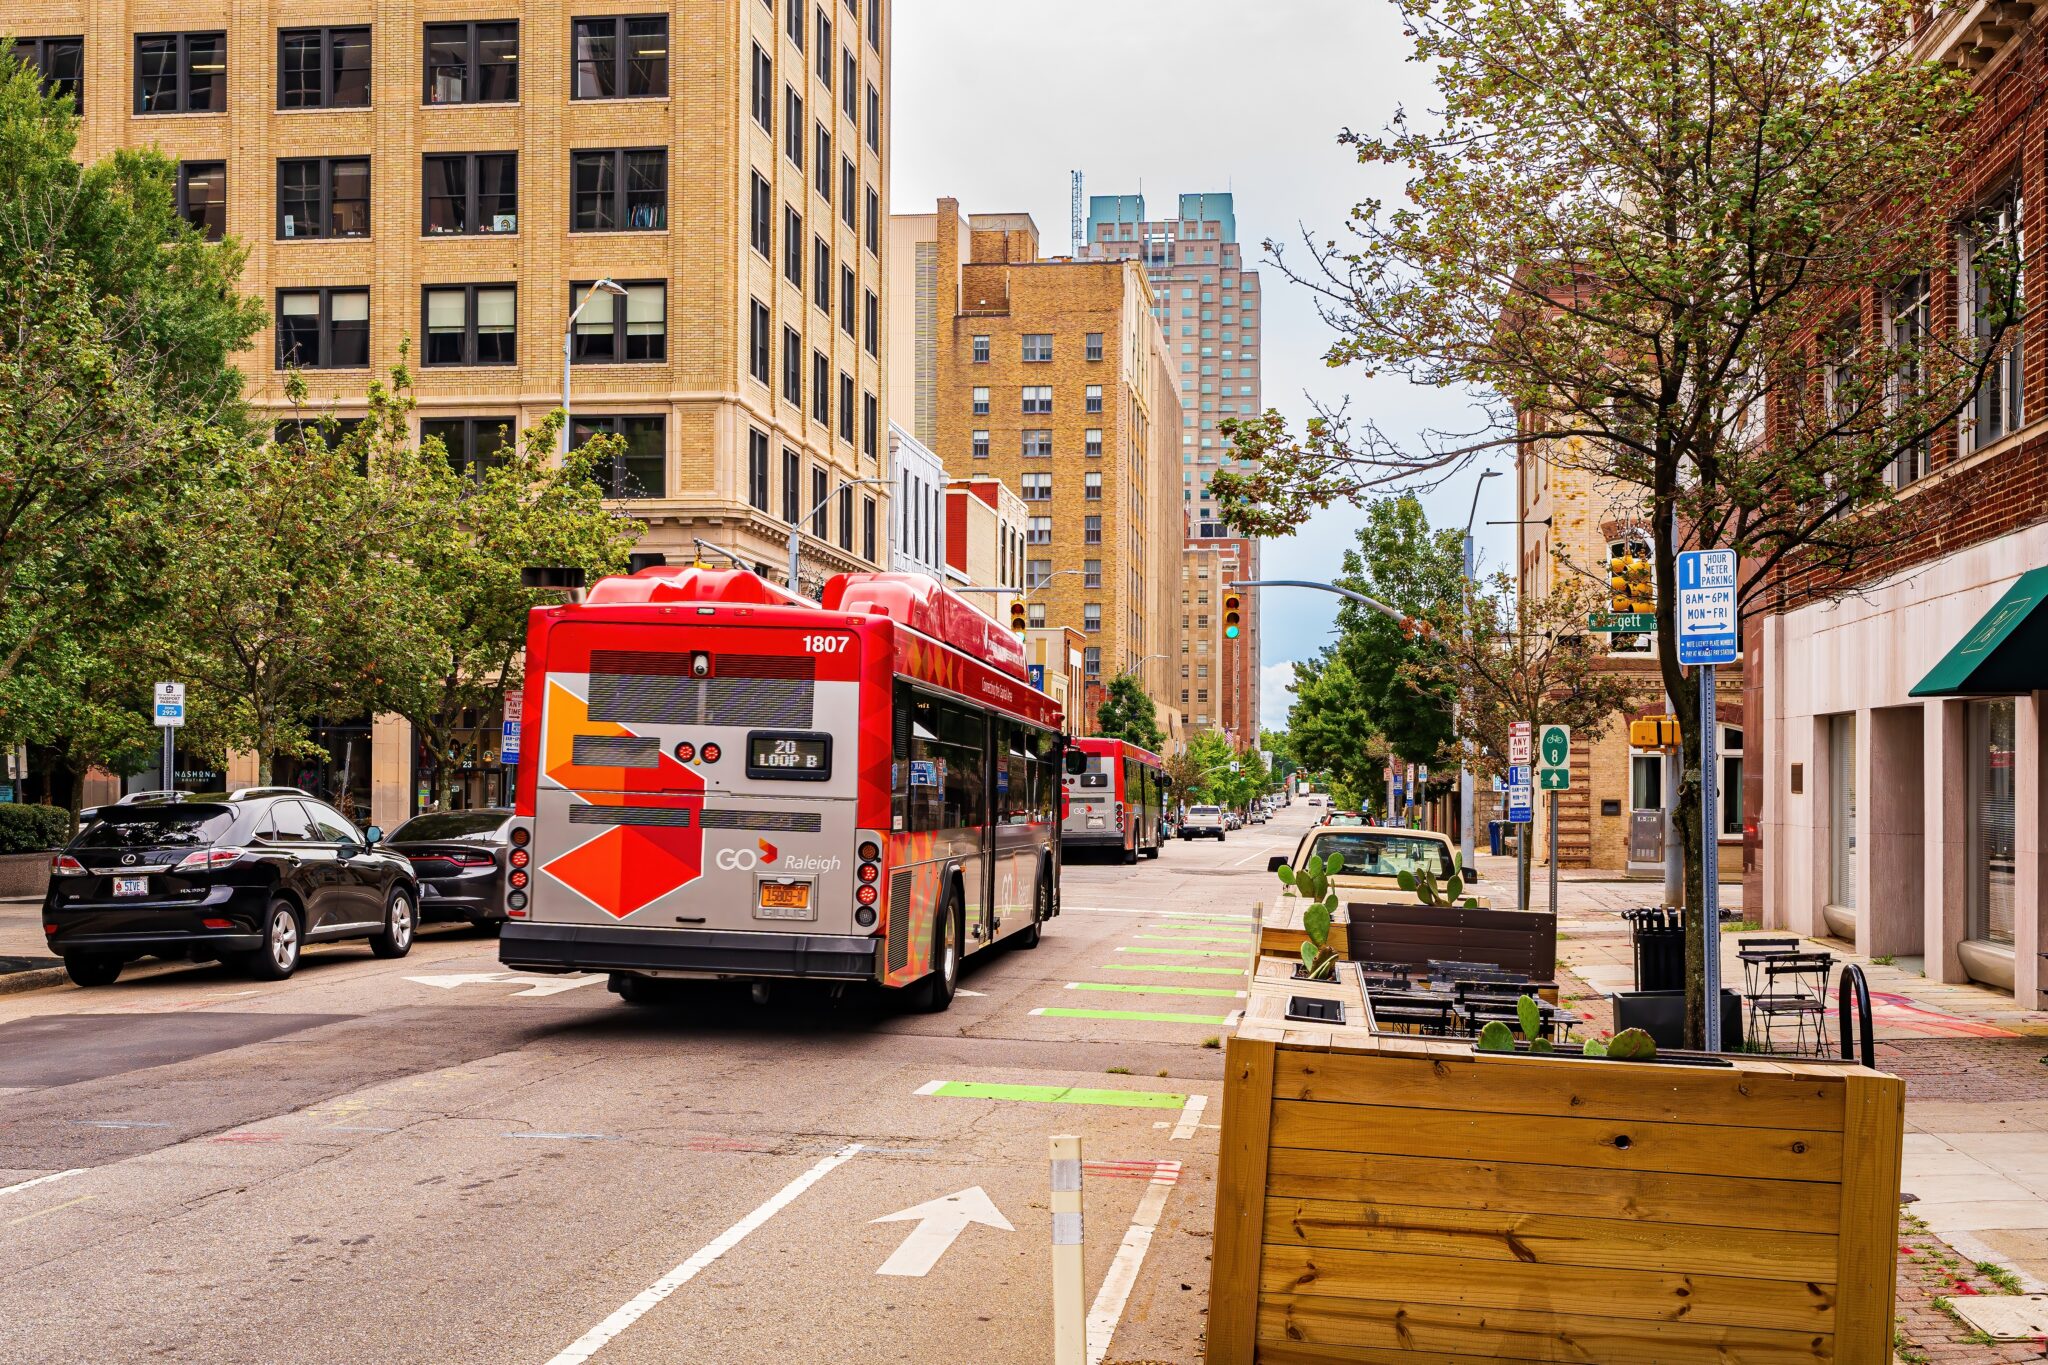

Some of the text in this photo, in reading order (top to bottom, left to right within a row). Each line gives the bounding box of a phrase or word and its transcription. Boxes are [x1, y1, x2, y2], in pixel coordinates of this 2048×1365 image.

[1687, 554, 1727, 584] 1 HOUR
[1706, 565, 1728, 575] METER
[1701, 575, 1733, 586] PARKING
[1687, 607, 1728, 619] MON-FRI
[802, 635, 850, 653] 1807
[774, 740, 797, 754] 20
[1513, 738, 1527, 746] ANY
[1512, 747, 1528, 756] TIME
[1551, 749, 1558, 763] 8
[759, 753, 818, 768] LOOP B
[1090, 776, 1096, 785] 2
[1512, 769, 1516, 783] 1
[1073, 807, 1086, 815] GO
[716, 848, 841, 873] GO Raleigh
